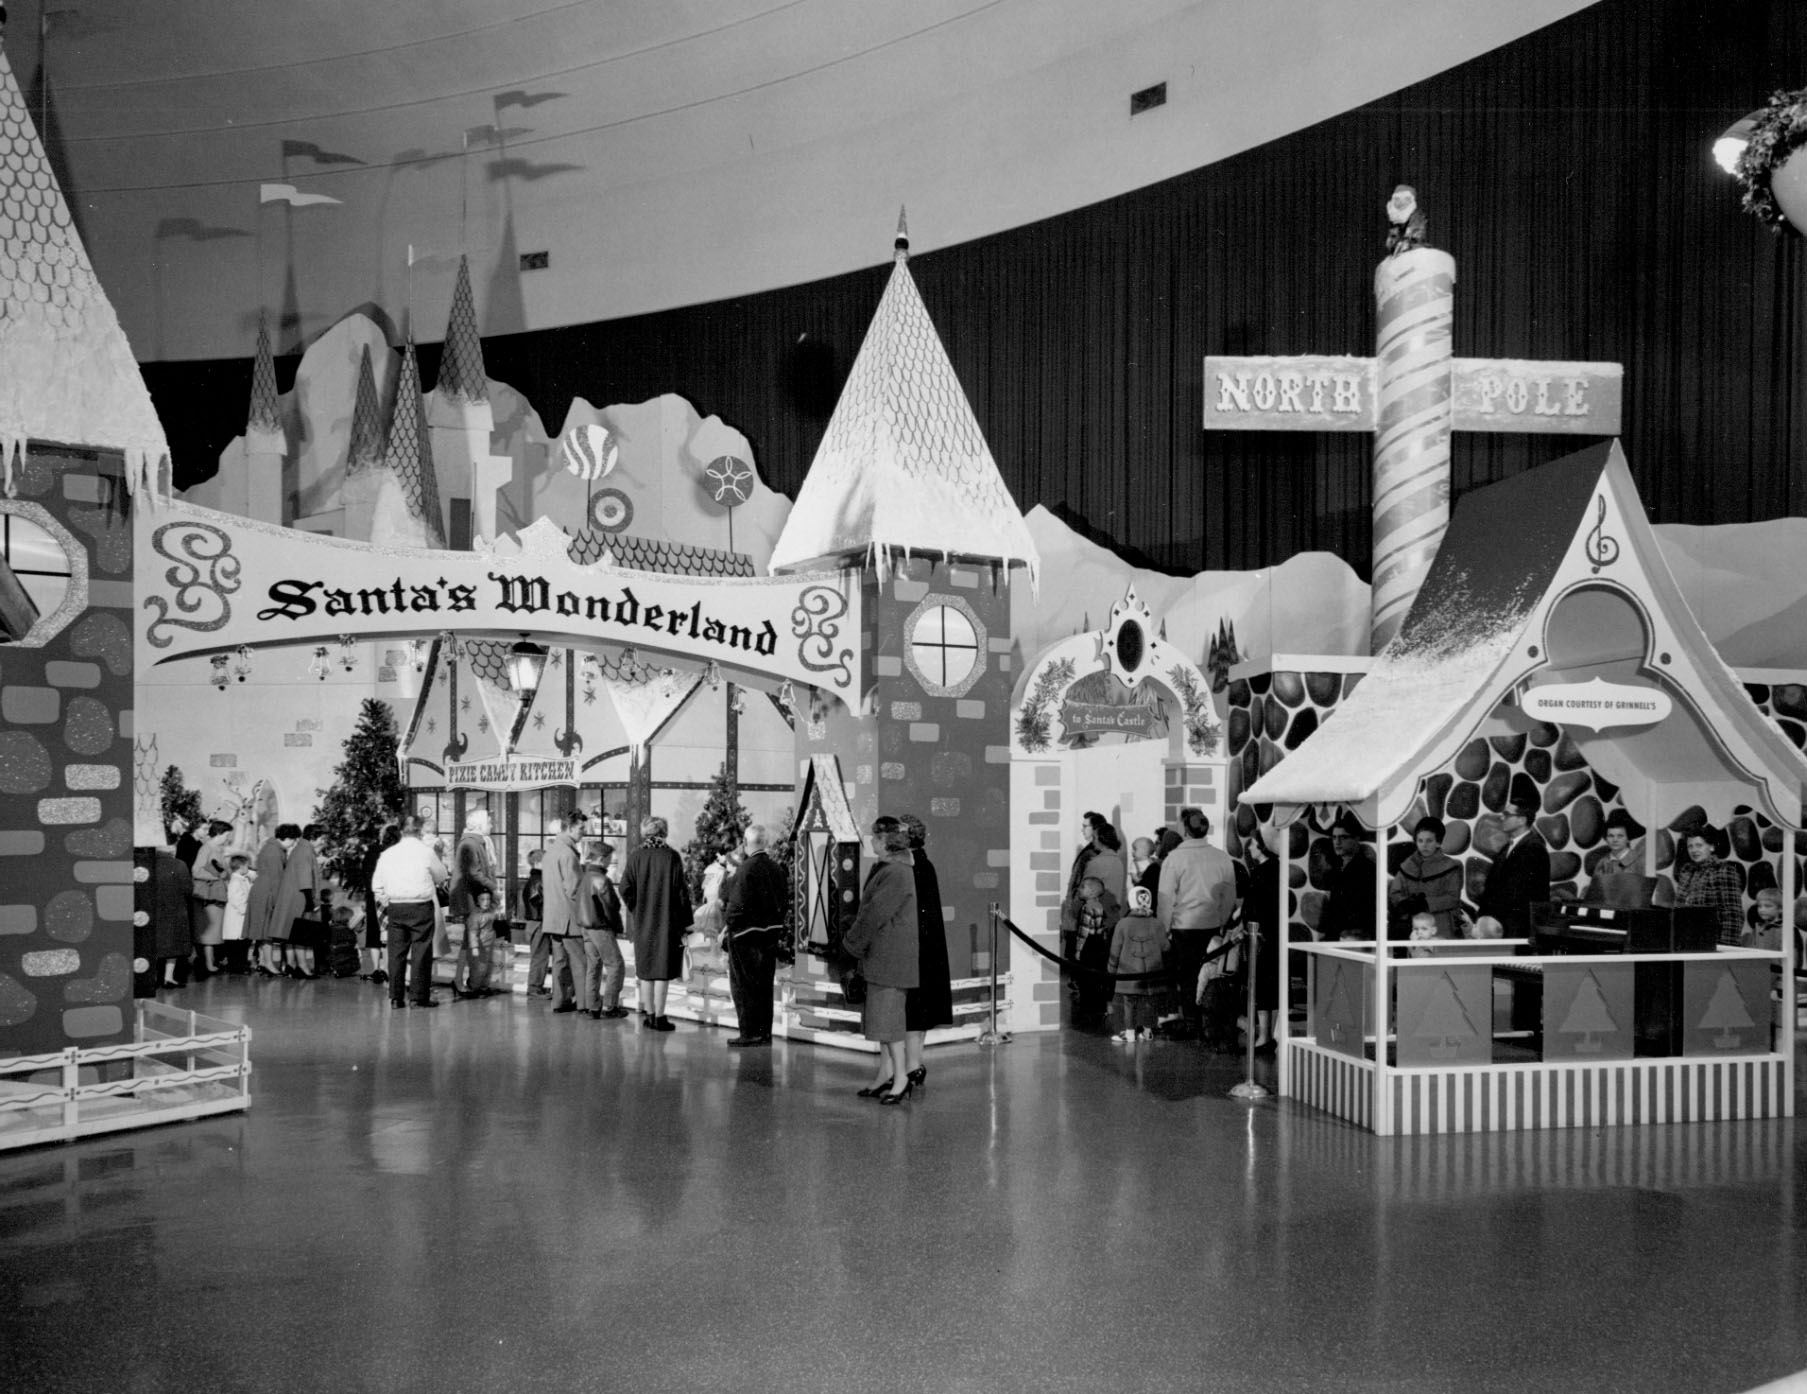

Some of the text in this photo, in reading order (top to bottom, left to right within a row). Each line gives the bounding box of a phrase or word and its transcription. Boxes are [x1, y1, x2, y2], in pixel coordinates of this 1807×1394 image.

[1215, 372, 1590, 416] NORTH POLE
[256, 571, 778, 656] Santa's Wonderland
[1537, 699, 1657, 710] ORGAN COURTESY OF GRINNELL'S
[1072, 714, 1081, 724] to
[1116, 711, 1146, 726] Castle
[448, 765, 477, 783] PIXIE
[519, 760, 575, 781] KITCHEN
